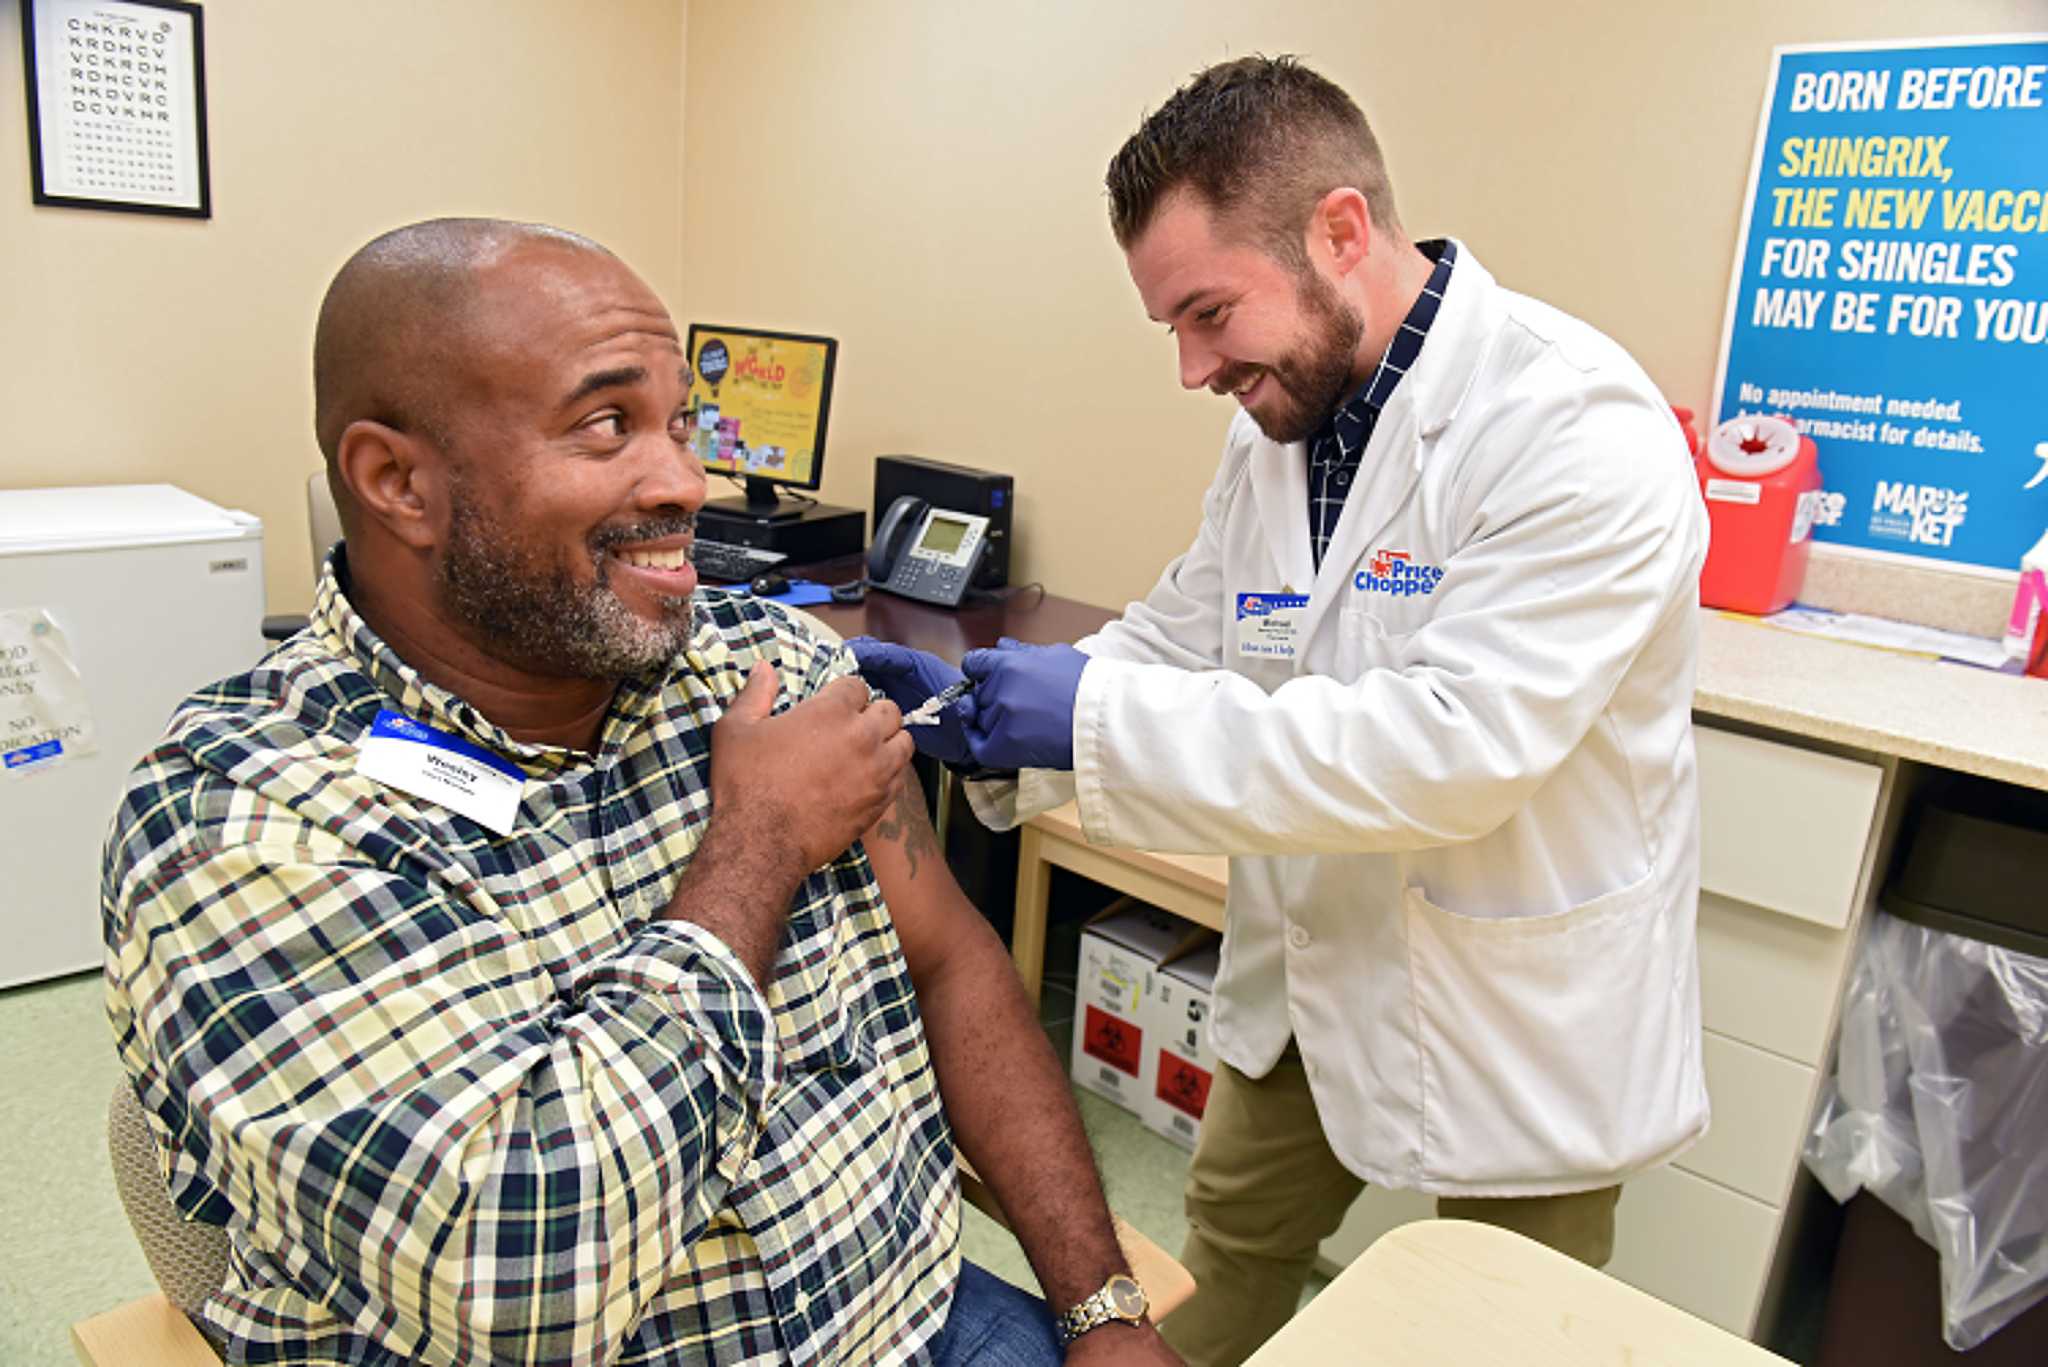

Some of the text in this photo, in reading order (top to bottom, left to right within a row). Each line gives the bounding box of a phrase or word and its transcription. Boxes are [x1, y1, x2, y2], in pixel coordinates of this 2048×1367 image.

[1790, 65, 2047, 112] BORN BEFORE
[1778, 135, 1953, 184] SHINGRIX,
[1772, 187, 1838, 228] THE
[1843, 188, 1934, 230] NEW
[1760, 237, 2018, 287] FOR SHINGLES
[1752, 287, 1826, 330] MAY
[1831, 290, 1880, 333] BE
[1887, 293, 1962, 339] FOR
[1739, 382, 1763, 403] No
[1767, 388, 1883, 414] appointment
[1886, 397, 1963, 423] needed.
[1776, 413, 1877, 443] armacist
[1879, 421, 1909, 446] for
[1913, 426, 1985, 453] details.
[1355, 571, 1438, 596] Choppe
[1391, 558, 1444, 581] Price
